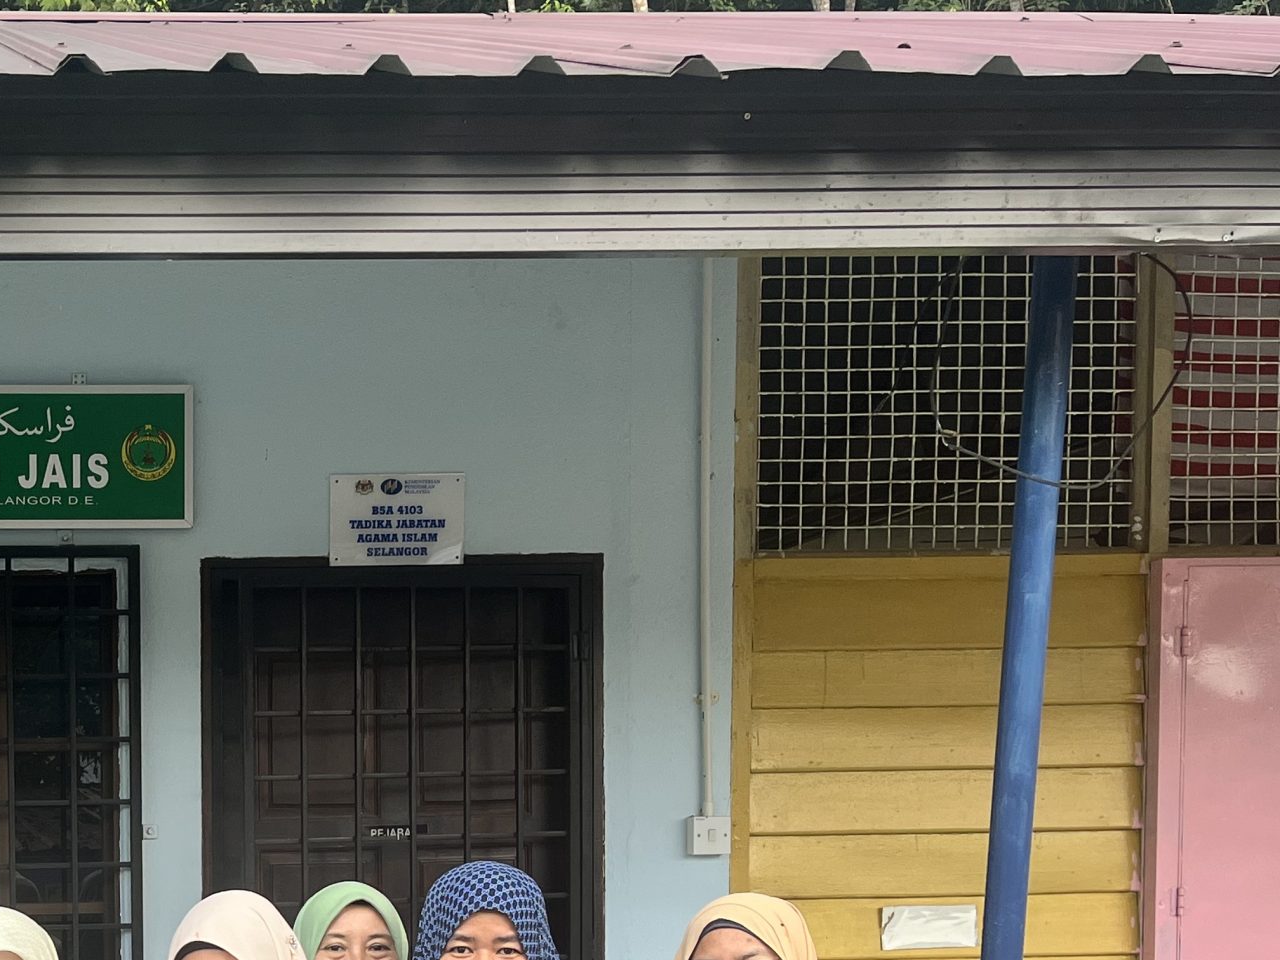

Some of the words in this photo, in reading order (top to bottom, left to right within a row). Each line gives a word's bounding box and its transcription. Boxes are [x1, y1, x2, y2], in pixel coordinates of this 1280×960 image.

[18, 453, 110, 489] JAIS
[397, 505, 423, 515] 4103
[349, 520, 393, 529] TADIKA
[396, 519, 446, 528] JABATAN
[357, 533, 399, 543] AGAMA
[402, 533, 438, 542] ISLAM
[367, 547, 428, 557] SELANGOR
